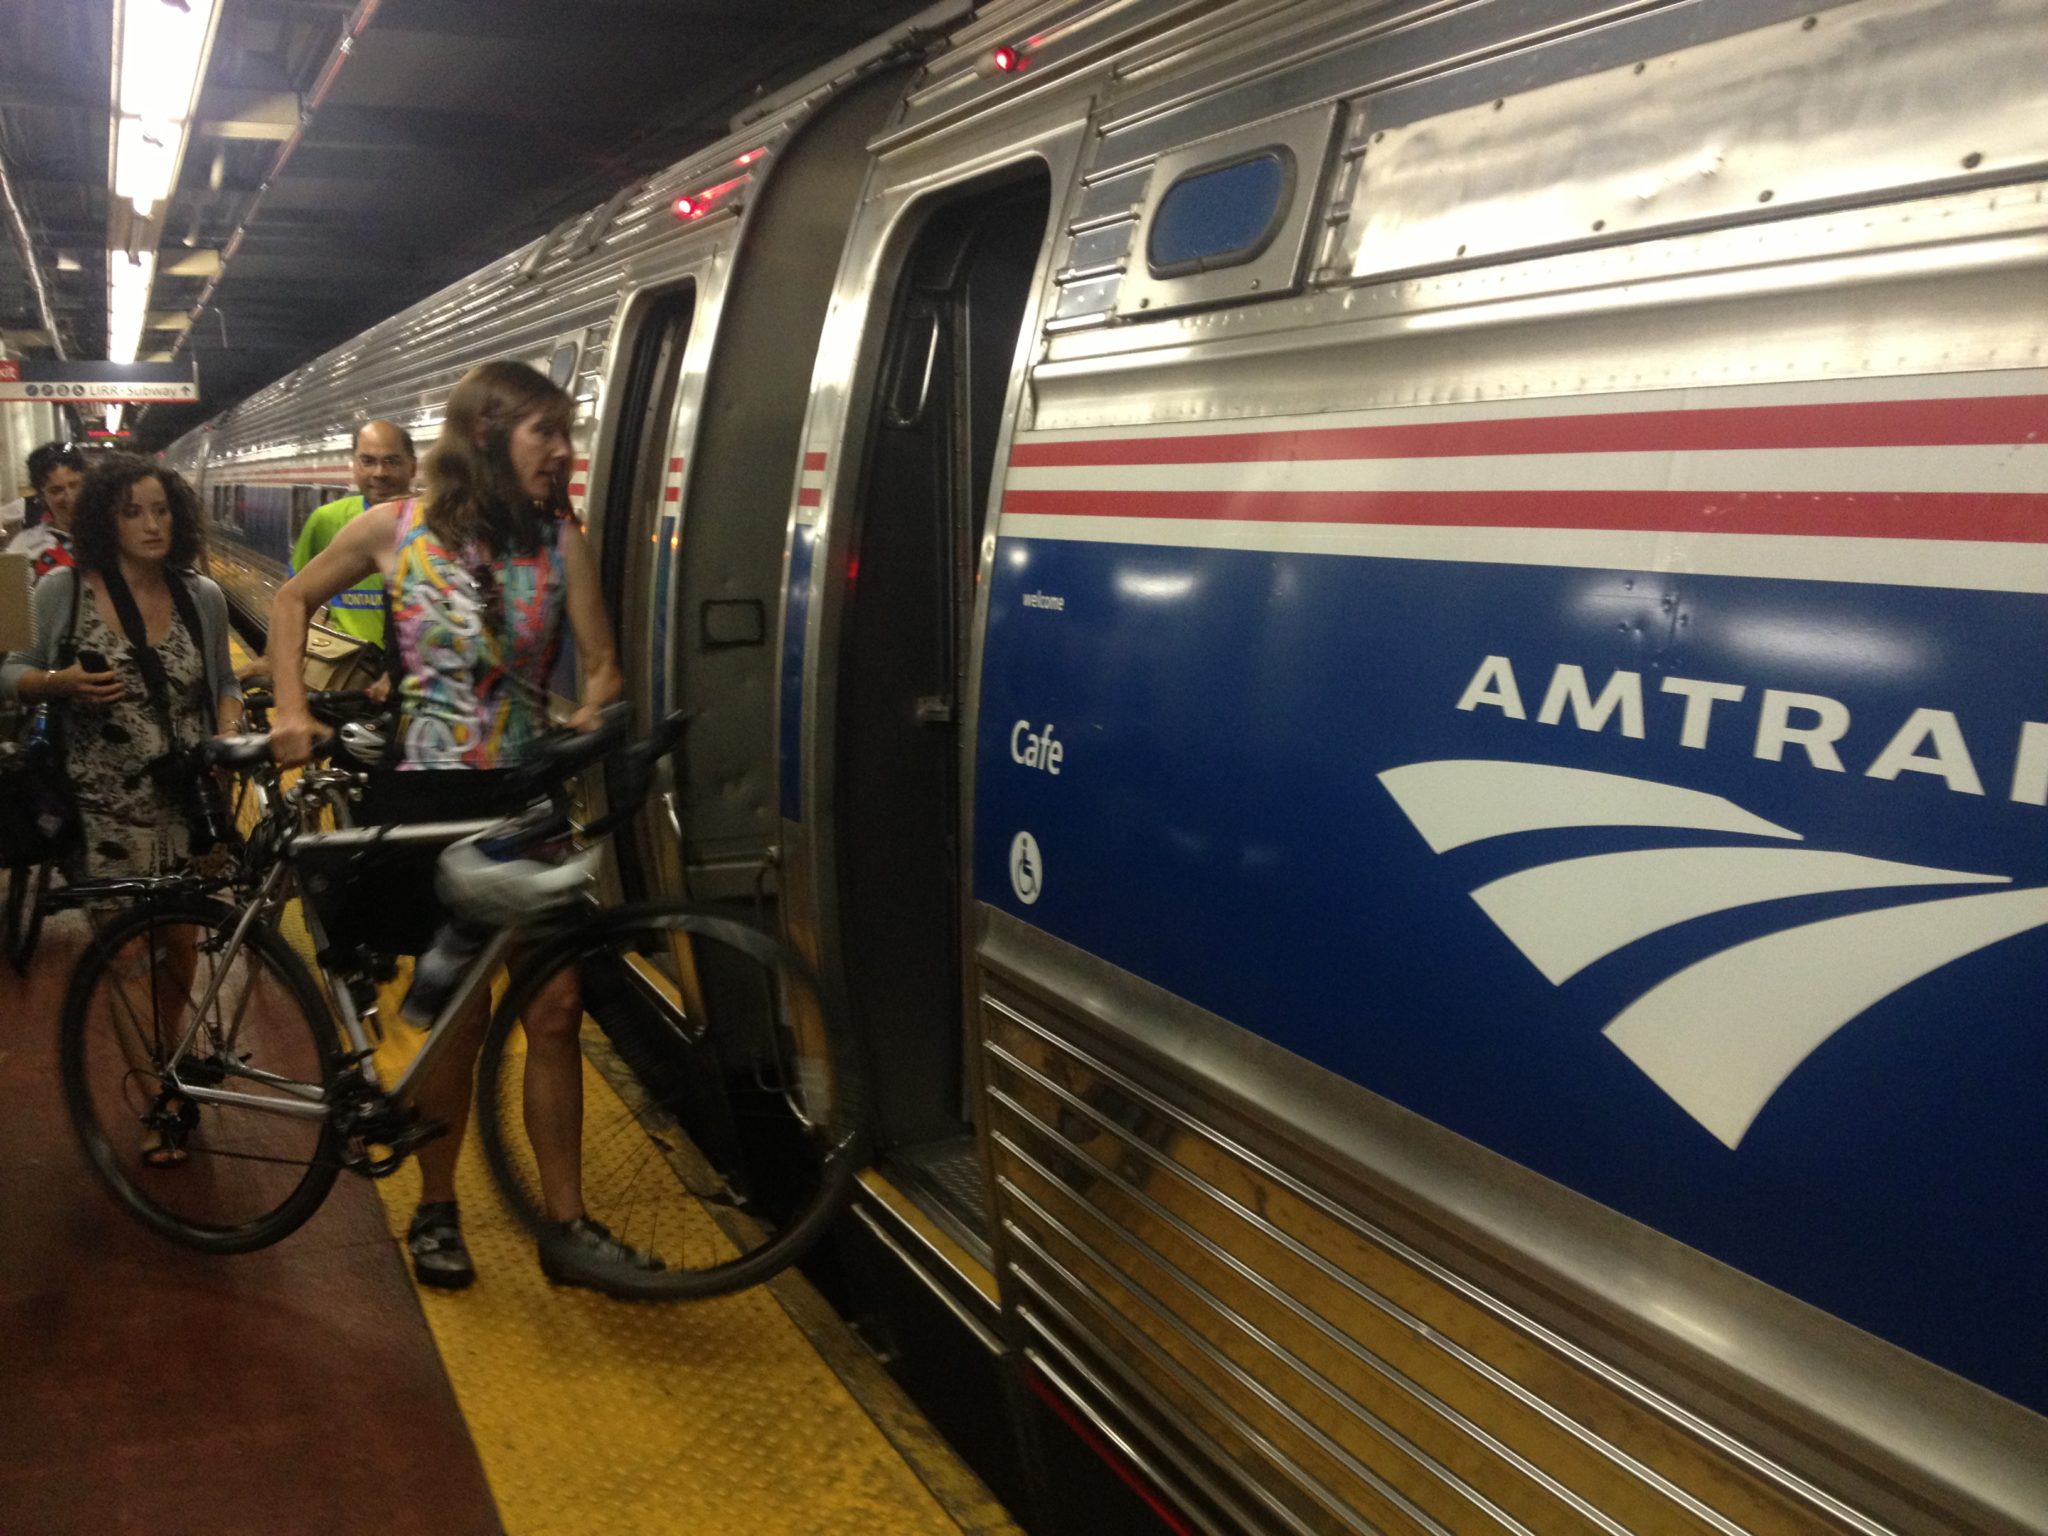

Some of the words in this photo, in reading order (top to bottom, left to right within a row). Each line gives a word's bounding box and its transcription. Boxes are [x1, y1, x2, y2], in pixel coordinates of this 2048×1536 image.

[89, 385, 119, 397] LIRR
[127, 385, 177, 400] Subway
[1022, 589, 1065, 611] welcome
[1010, 719, 1064, 776] Cafe
